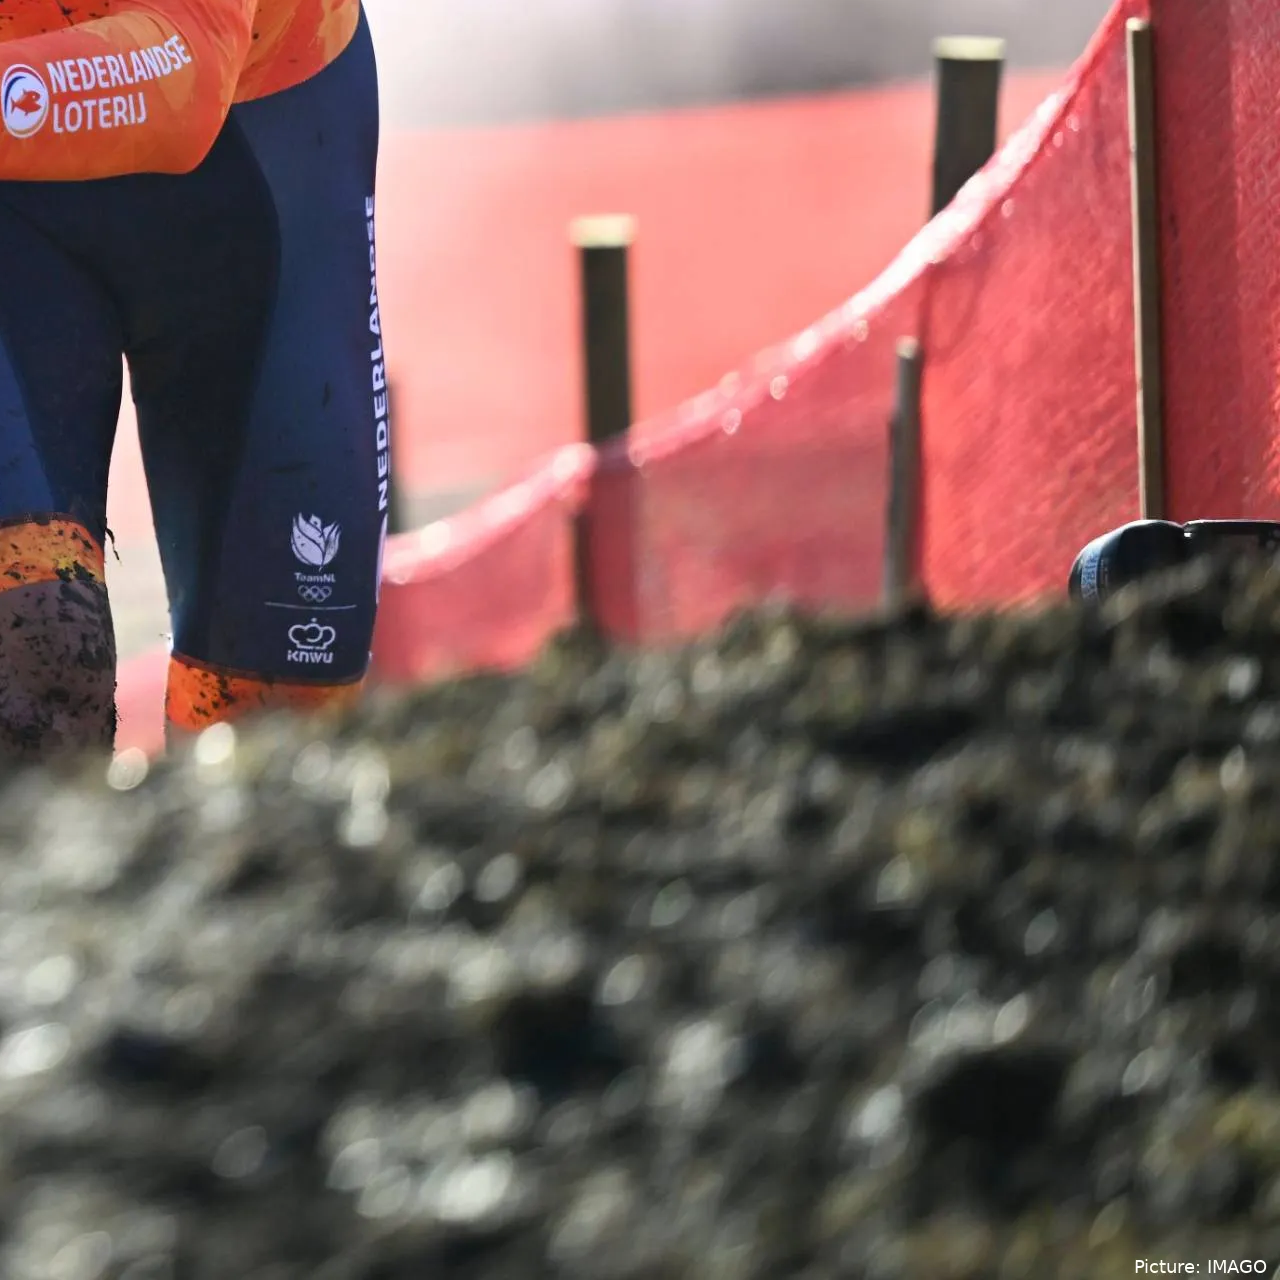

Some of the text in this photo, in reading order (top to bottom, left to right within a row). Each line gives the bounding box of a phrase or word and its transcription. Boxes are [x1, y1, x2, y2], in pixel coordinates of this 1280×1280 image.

[46, 34, 192, 95] NEDERLANDSE
[52, 91, 148, 134] LOTERIJ
[294, 572, 336, 583] TeamNL
